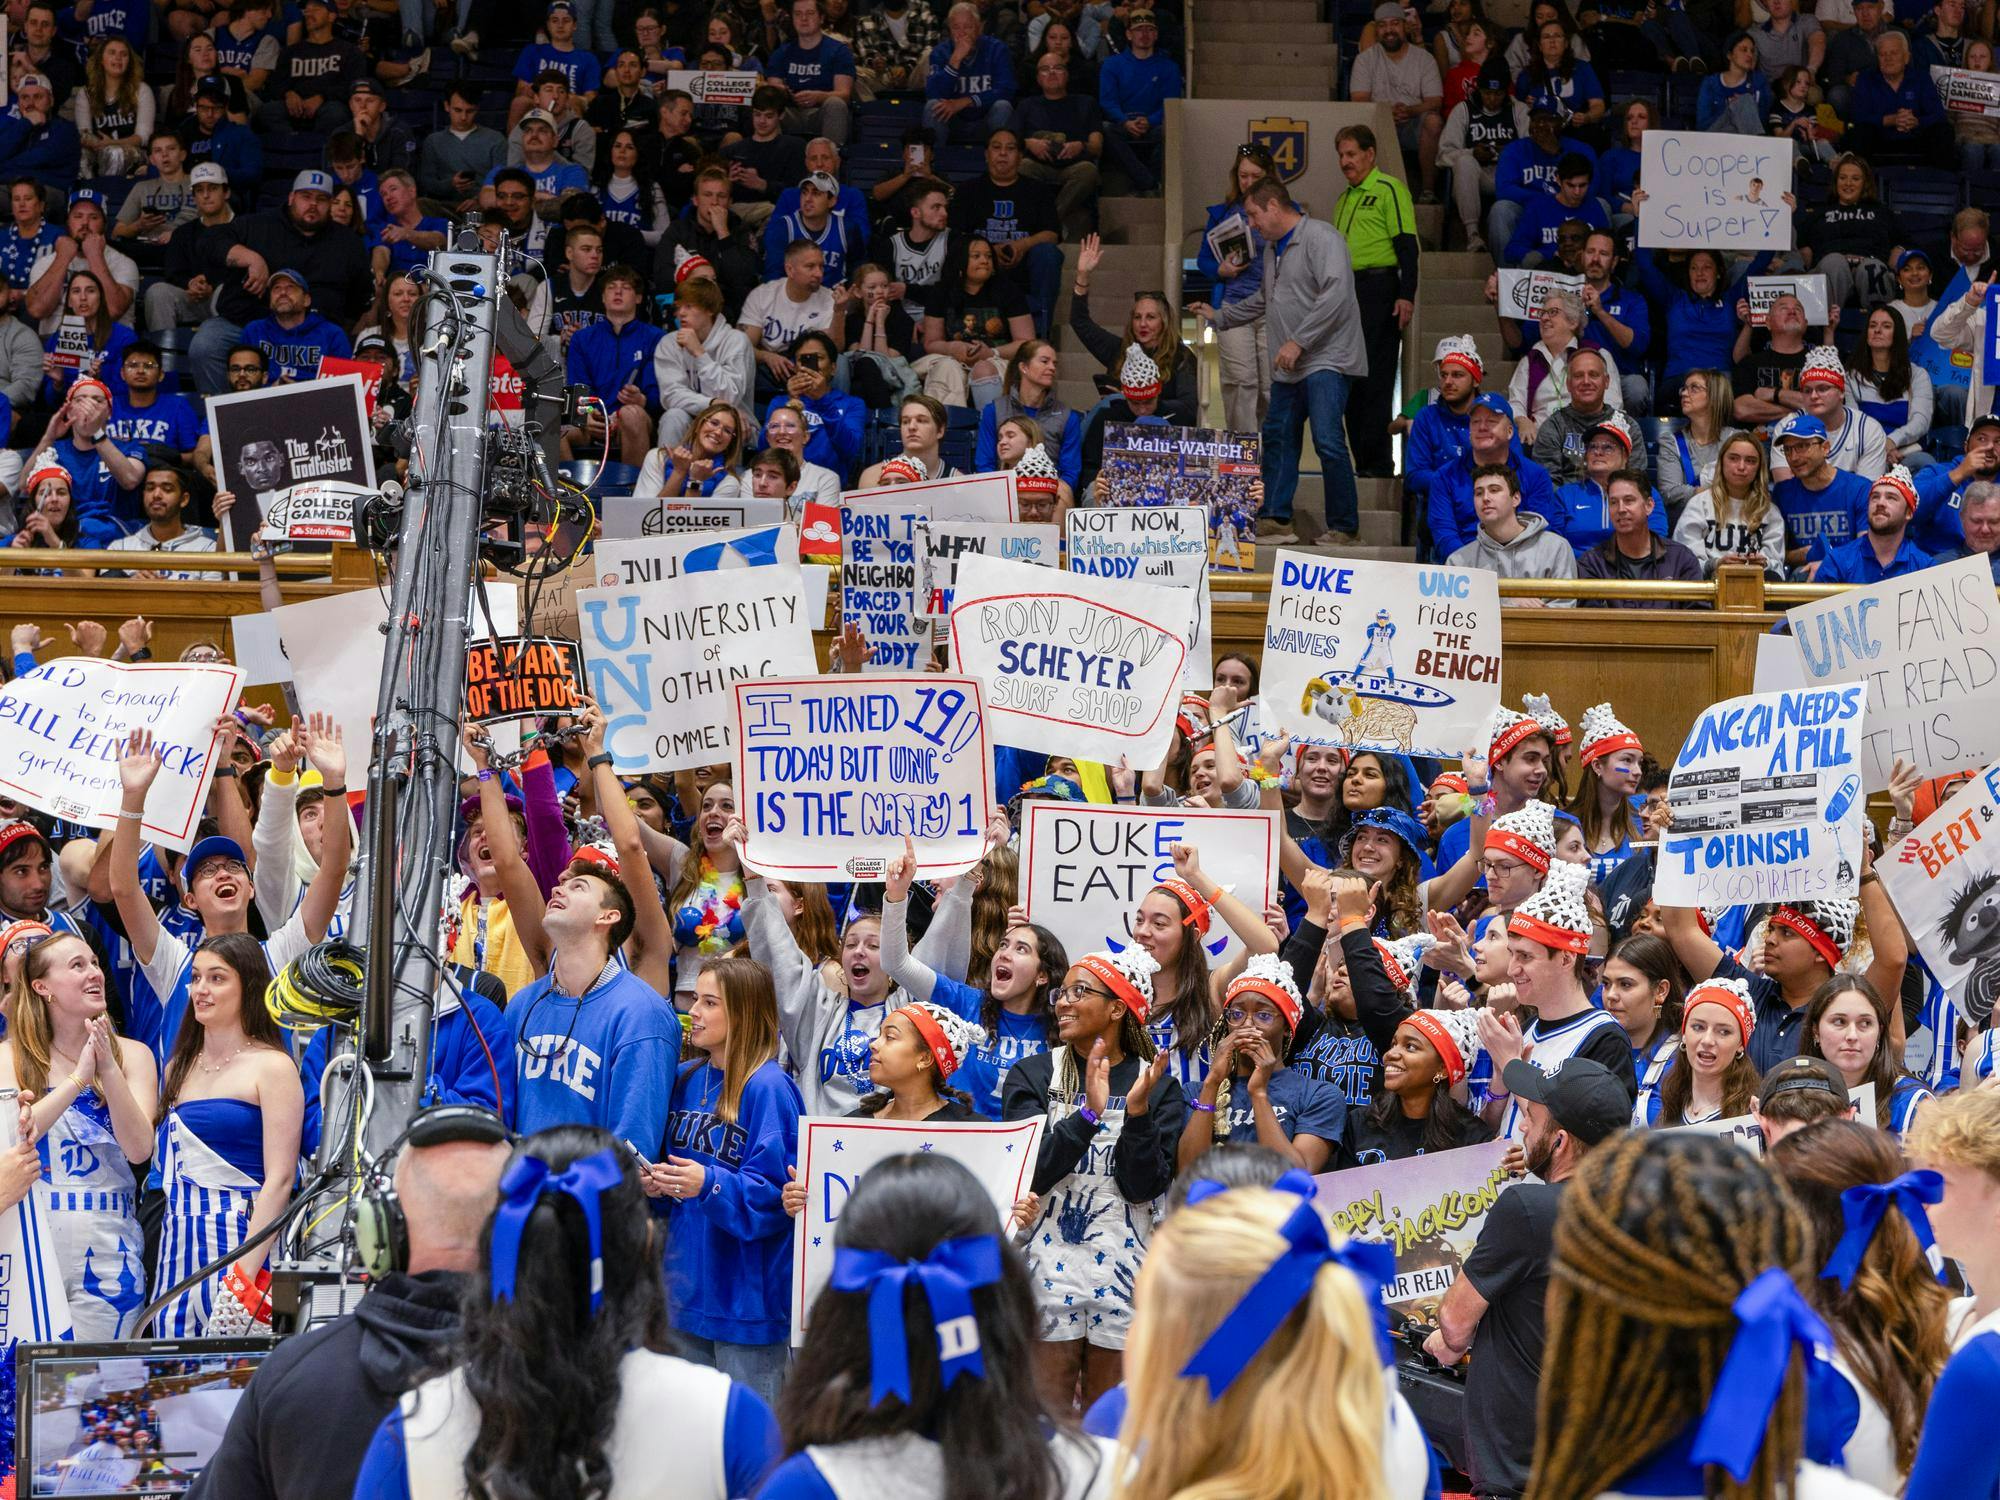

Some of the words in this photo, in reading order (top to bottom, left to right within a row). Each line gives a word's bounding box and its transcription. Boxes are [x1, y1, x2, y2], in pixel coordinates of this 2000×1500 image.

[88, 10, 126, 36] DUKE
[219, 45, 251, 66] DUKE
[291, 55, 341, 77] DUKE
[540, 59, 578, 76] DUKE
[789, 63, 821, 76] DUKE
[706, 80, 751, 88] COLLEGE
[706, 87, 754, 95] GAMEDAY
[955, 75, 992, 93] UKE
[1951, 82, 1993, 93] COLLEGE
[1469, 123, 1515, 140] Duke
[1661, 138, 1772, 177] Cooper
[1523, 164, 1560, 184] DUK
[146, 193, 197, 208] DUKE
[1704, 185, 1726, 206] is
[606, 209, 641, 228] UKE
[1661, 205, 1779, 239] Super!
[1825, 209, 1876, 222] Duke
[900, 263, 940, 281] Duke
[260, 341, 322, 364] DUKE
[1805, 369, 1822, 378] State
[1822, 370, 1838, 379] Farm
[285, 438, 309, 460] The
[1127, 437, 1242, 460] Malu-WATCH
[293, 486, 321, 496] ESPN
[1028, 480, 1046, 488] State
[305, 527, 324, 536] State
[325, 528, 345, 538] Farm
[666, 516, 730, 527] COLLEGE
[841, 508, 890, 538] BORN
[1072, 511, 1116, 532] NOT
[1131, 511, 1185, 534] NOW,
[1788, 514, 1851, 537] DUKE
[853, 541, 880, 562] BE
[885, 538, 914, 563] YOU
[925, 535, 985, 560] WHEN
[1001, 536, 1041, 560] UNC
[1072, 535, 1125, 556] Kitten
[843, 564, 914, 588] NEIGHBO
[1072, 556, 1139, 578] DADDY
[1145, 558, 1174, 577] will
[1281, 560, 1354, 594] DUKE
[1418, 571, 1470, 599] UNC
[844, 591, 900, 612] FORCED
[1280, 595, 1342, 625] rides
[862, 613, 908, 637] YOUR
[1418, 603, 1477, 630] rides
[1795, 597, 1881, 678] UNC
[1897, 573, 1989, 653] FANS
[981, 601, 1060, 643] RON
[1069, 607, 1165, 667] JON
[1267, 625, 1340, 659] WAVES
[1433, 631, 1472, 650] THE
[469, 645, 573, 683] BEWARE
[702, 644, 721, 661] of
[870, 642, 919, 671] ADDY
[998, 640, 1134, 690] SCHEYER
[1415, 648, 1500, 684] BENCH
[1903, 647, 1997, 709] READ
[100, 685, 182, 723] enough
[469, 684, 492, 717] OF
[496, 680, 533, 711] THE
[992, 675, 1057, 713] SURF
[1068, 686, 1142, 727] SHOP
[1777, 687, 1861, 728] NEEDS
[0, 695, 61, 743] BILL
[74, 704, 96, 723] to
[103, 714, 127, 733] be
[747, 693, 792, 737] I
[801, 694, 900, 736] TURNED
[1500, 730, 1521, 750] State
[1520, 721, 1540, 736] Farm
[1766, 735, 1788, 777] A
[1796, 727, 1852, 771] PILL
[748, 746, 835, 783] TODAY
[841, 746, 884, 782] BUT
[889, 748, 939, 785] UNC
[757, 792, 786, 834] IS
[792, 790, 854, 837] THE
[861, 792, 951, 838] NASTY
[957, 794, 978, 836] 1
[0, 823, 24, 840] State
[1055, 819, 1185, 857] DUKE
[1898, 838, 1921, 864] HU
[1918, 807, 1983, 880] BERT
[1981, 804, 1995, 823] &
[1519, 844, 1541, 865] State
[1176, 881, 1200, 904] Farm
[1791, 912, 1817, 938] Farm
[1089, 957, 1115, 979] Farm
[1236, 979, 1264, 995] Farm
[1418, 1016, 1443, 1037] Farm
[515, 1034, 602, 1102] UKE
[977, 1051, 1008, 1068] BLUE
[668, 1110, 750, 1169] UKE
